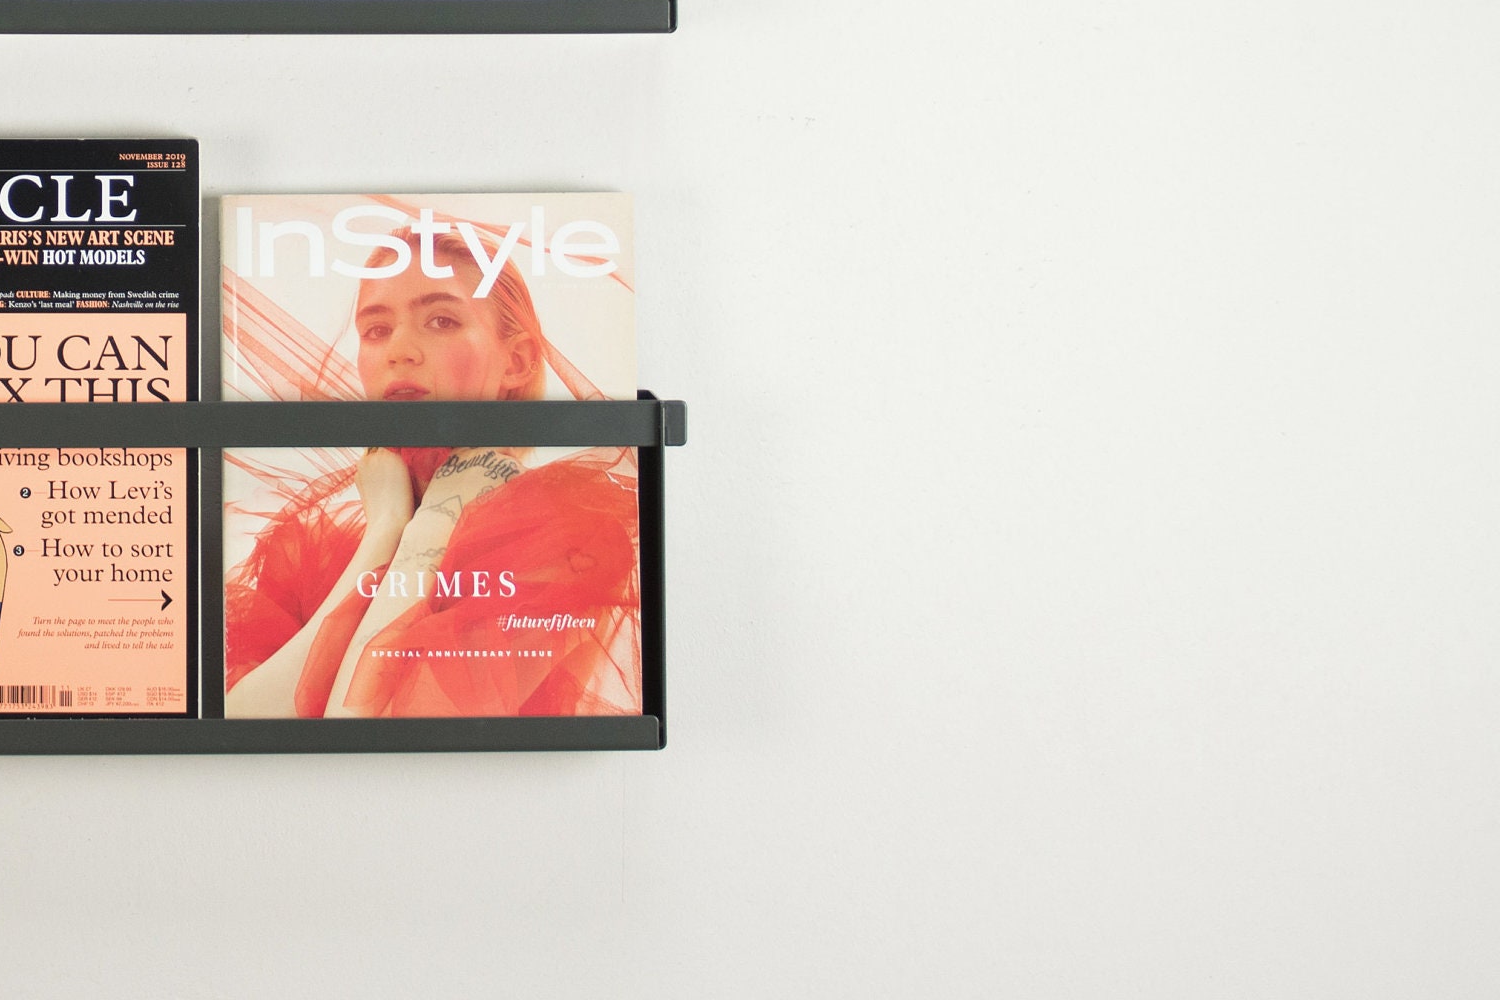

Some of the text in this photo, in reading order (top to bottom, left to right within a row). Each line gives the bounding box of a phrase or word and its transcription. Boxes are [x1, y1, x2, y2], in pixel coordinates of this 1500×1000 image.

[119, 153, 185, 162] NOVEMBER 2019
[146, 160, 185, 169] ISSUE 128
[46, 231, 84, 245] NEW
[87, 231, 120, 245] ART
[124, 230, 174, 245] SCENE
[43, 250, 76, 264] HOT
[80, 250, 145, 265] MODELS
[235, 204, 621, 298] InStyle
[15, 290, 50, 299] CULTURE:
[52, 291, 80, 299] Making
[81, 292, 106, 300] money
[107, 290, 125, 299] from
[127, 290, 156, 299] Swedish
[158, 291, 179, 299] crime
[57, 335, 172, 370] CAN
[57, 449, 172, 470] bookshops
[48, 481, 100, 499] How
[110, 481, 172, 499] Levi's
[42, 506, 172, 528] got mended
[42, 539, 93, 557] How
[102, 543, 122, 557] to
[131, 543, 172, 557] sort
[54, 564, 172, 586] your home
[356, 569, 517, 598] GRIMES
[495, 613, 596, 632] #futurefifteen
[371, 650, 552, 659] SPECIAL ANNIVERSARY ISSUE
